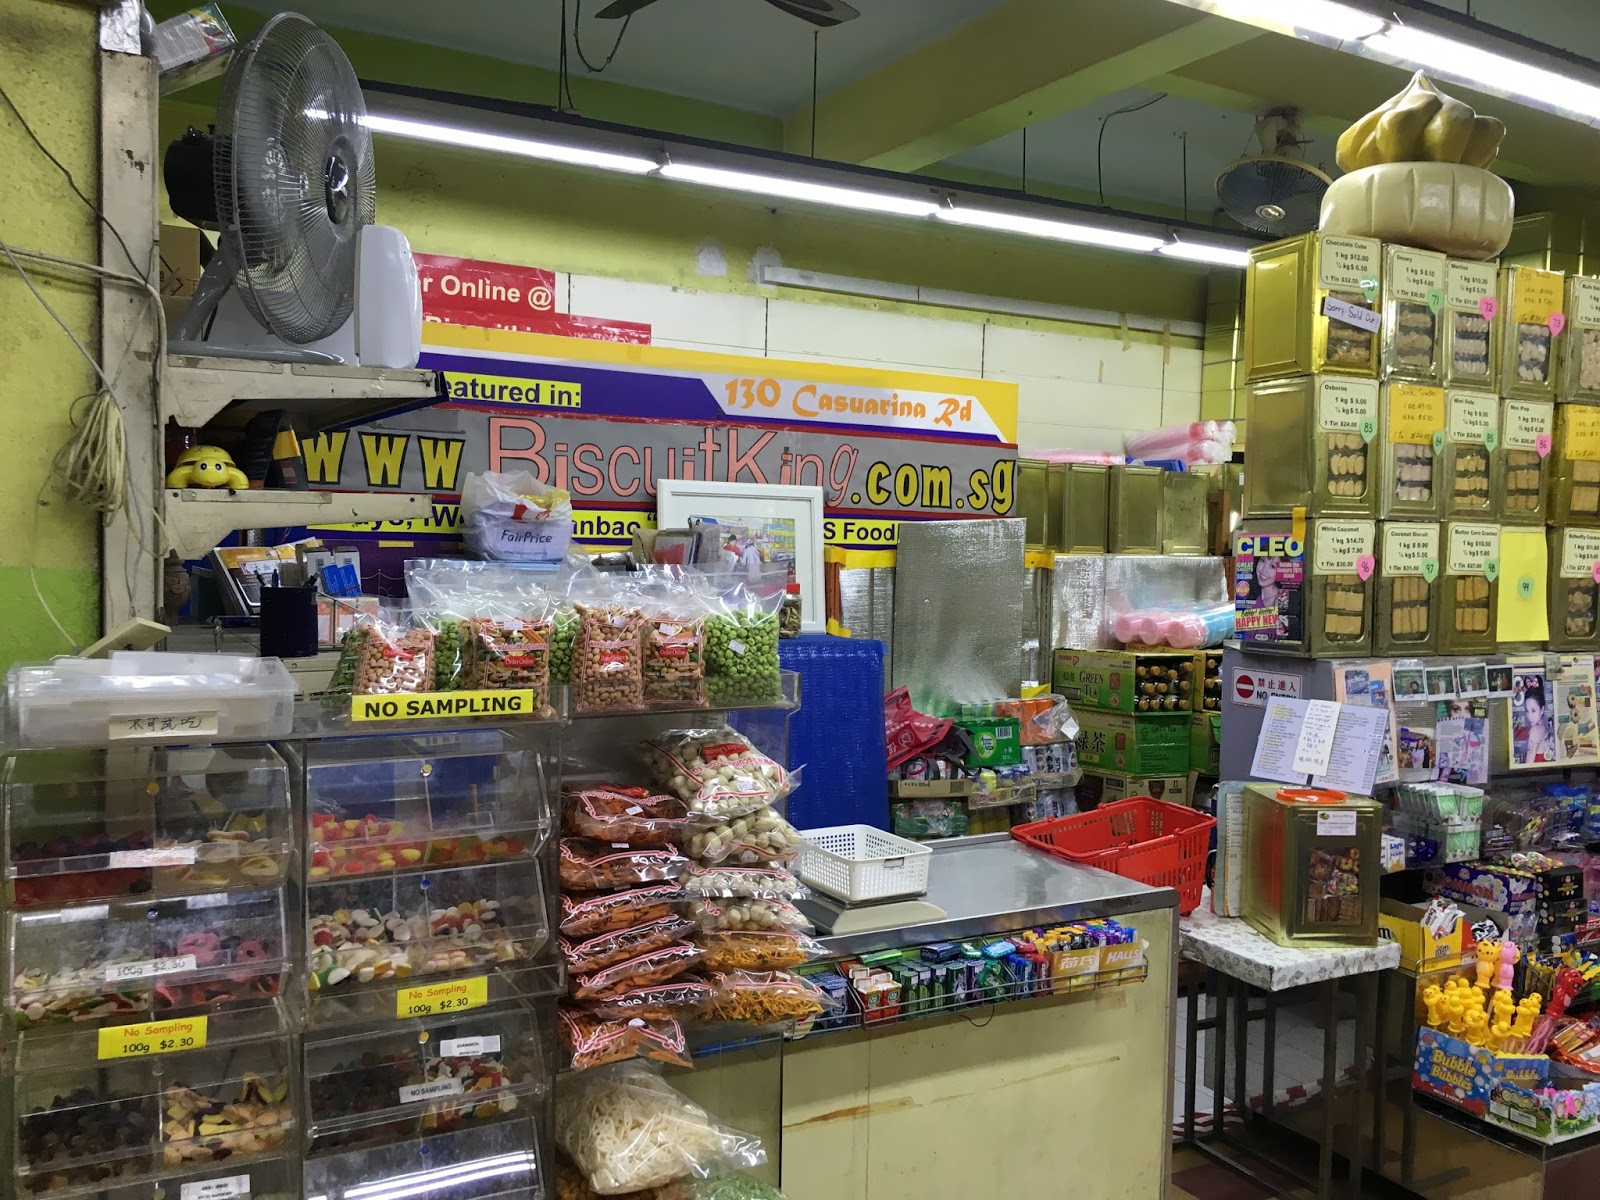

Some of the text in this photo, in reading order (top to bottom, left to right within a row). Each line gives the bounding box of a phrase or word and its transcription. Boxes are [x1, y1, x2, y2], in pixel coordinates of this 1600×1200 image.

[1326, 239, 1353, 248] Chocolate
[1341, 252, 1348, 260] kg
[1350, 252, 1369, 261] $12.00
[1410, 267, 1418, 275] kg
[1464, 276, 1471, 284] kg
[441, 275, 521, 304] Online
[528, 286, 552, 311] @
[1431, 295, 1440, 306] 71
[1484, 302, 1493, 312] 72
[1552, 318, 1561, 328] 73
[447, 378, 580, 406] eatured in:
[725, 378, 972, 428] 130 Casuarina Rd
[1364, 422, 1373, 433] 83
[1435, 436, 1442, 446] 84
[1539, 440, 1547, 449] 86
[571, 516, 641, 536] anbao
[844, 522, 895, 541] Food
[501, 529, 553, 544] FairPrice
[1237, 537, 1304, 557] CLEO
[1467, 540, 1473, 548] kg
[1578, 544, 1584, 552] kg
[1361, 561, 1370, 573] 96
[1425, 563, 1434, 574] 97
[1488, 563, 1495, 573] 98
[1522, 583, 1529, 592] 99
[1236, 616, 1260, 629] HAPPY
[1079, 670, 1104, 684] GREEN
[1084, 684, 1098, 698] TEA
[1257, 690, 1267, 700] NO
[365, 696, 522, 718] NO SAMPLING
[1106, 949, 1140, 964] HALLS
[152, 960, 186, 973] $2.30
[408, 984, 467, 1000] No Sampling
[408, 997, 469, 1014] 100g $2.30
[124, 1023, 194, 1037] No Sampling
[123, 1037, 194, 1054] 100g $2.30
[1432, 1048, 1477, 1077] Bubble
[1431, 1065, 1473, 1092] Bubbles
[411, 1083, 453, 1097] NO SAMPLING
